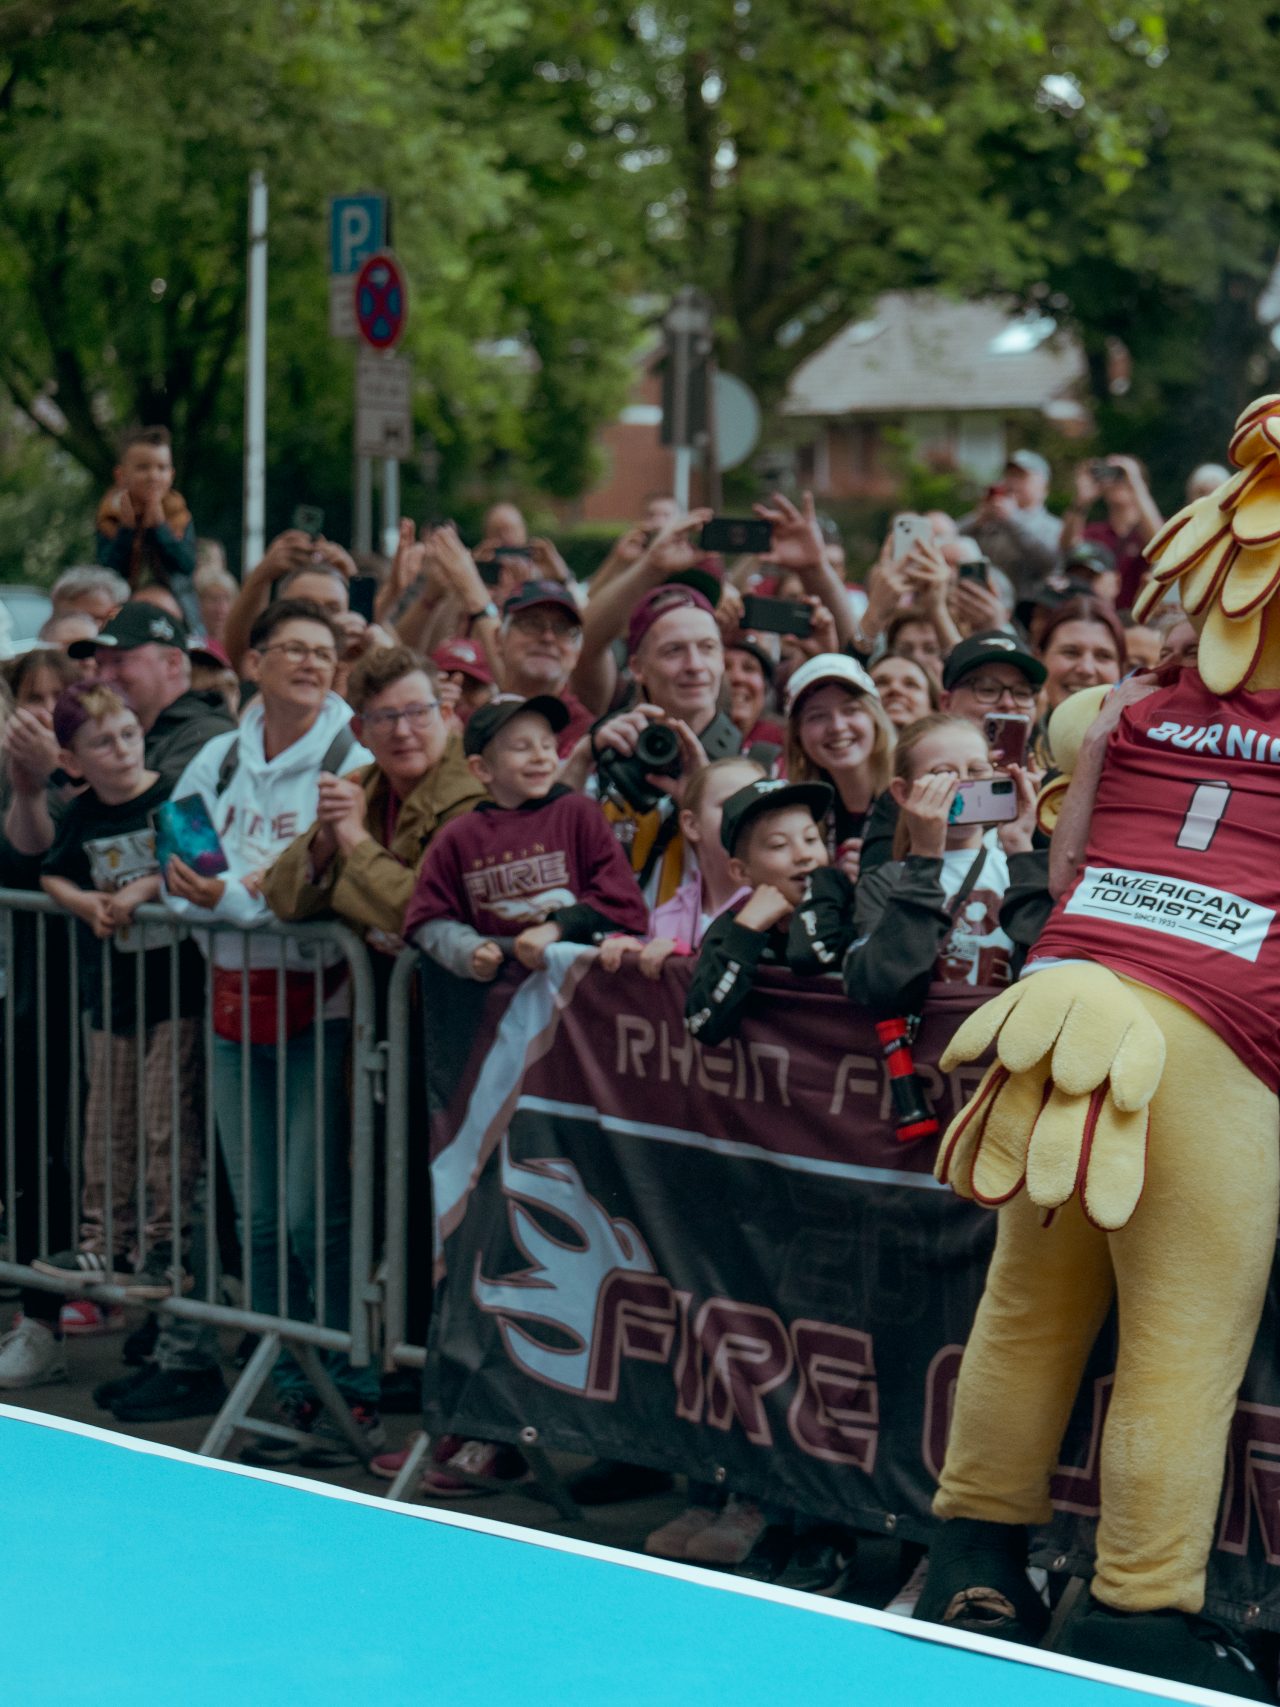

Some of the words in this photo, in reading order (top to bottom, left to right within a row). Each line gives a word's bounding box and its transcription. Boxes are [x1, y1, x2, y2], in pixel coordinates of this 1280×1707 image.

[340, 204, 371, 273] P
[1175, 778, 1232, 852] 1
[462, 850, 570, 916] FIRE
[1090, 886, 1242, 936] TOURISTER
[1098, 872, 1251, 920] AMERICAN
[1133, 912, 1156, 924] SINCE
[1158, 917, 1176, 928] 1933
[616, 1013, 792, 1107] RHEIN
[584, 1266, 880, 1477] FIRE
